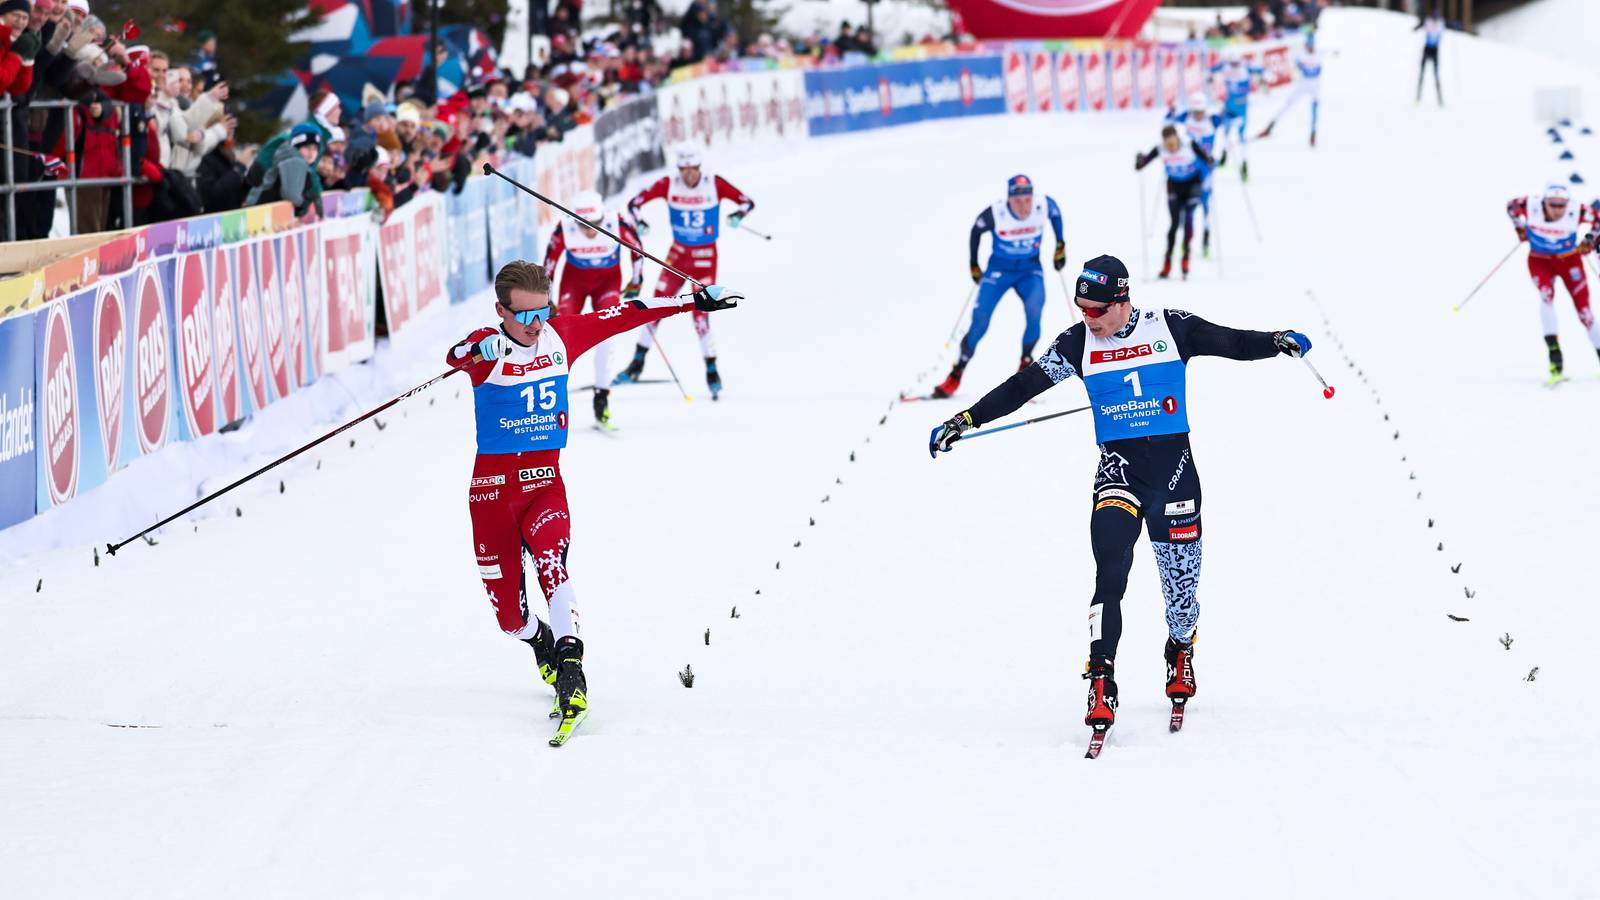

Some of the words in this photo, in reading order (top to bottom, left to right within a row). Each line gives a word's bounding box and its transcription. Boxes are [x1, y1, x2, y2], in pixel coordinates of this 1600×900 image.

[680, 211, 706, 228] 13
[183, 289, 211, 387] RIIS
[139, 312, 166, 397] RIIS
[1102, 345, 1150, 361] SPAR
[1123, 370, 1142, 397] 1
[48, 351, 72, 443] RIIS
[520, 380, 557, 413] 15
[1101, 398, 1160, 416] SpareBank
[1113, 409, 1161, 421] ØSTLANDET
[500, 412, 556, 430] SpareBank
[514, 423, 557, 434] ØSTLANDET
[471, 478, 495, 486] SPAR
[1168, 456, 1187, 491] CRAFT
[1171, 530, 1198, 539] ELDORADO
